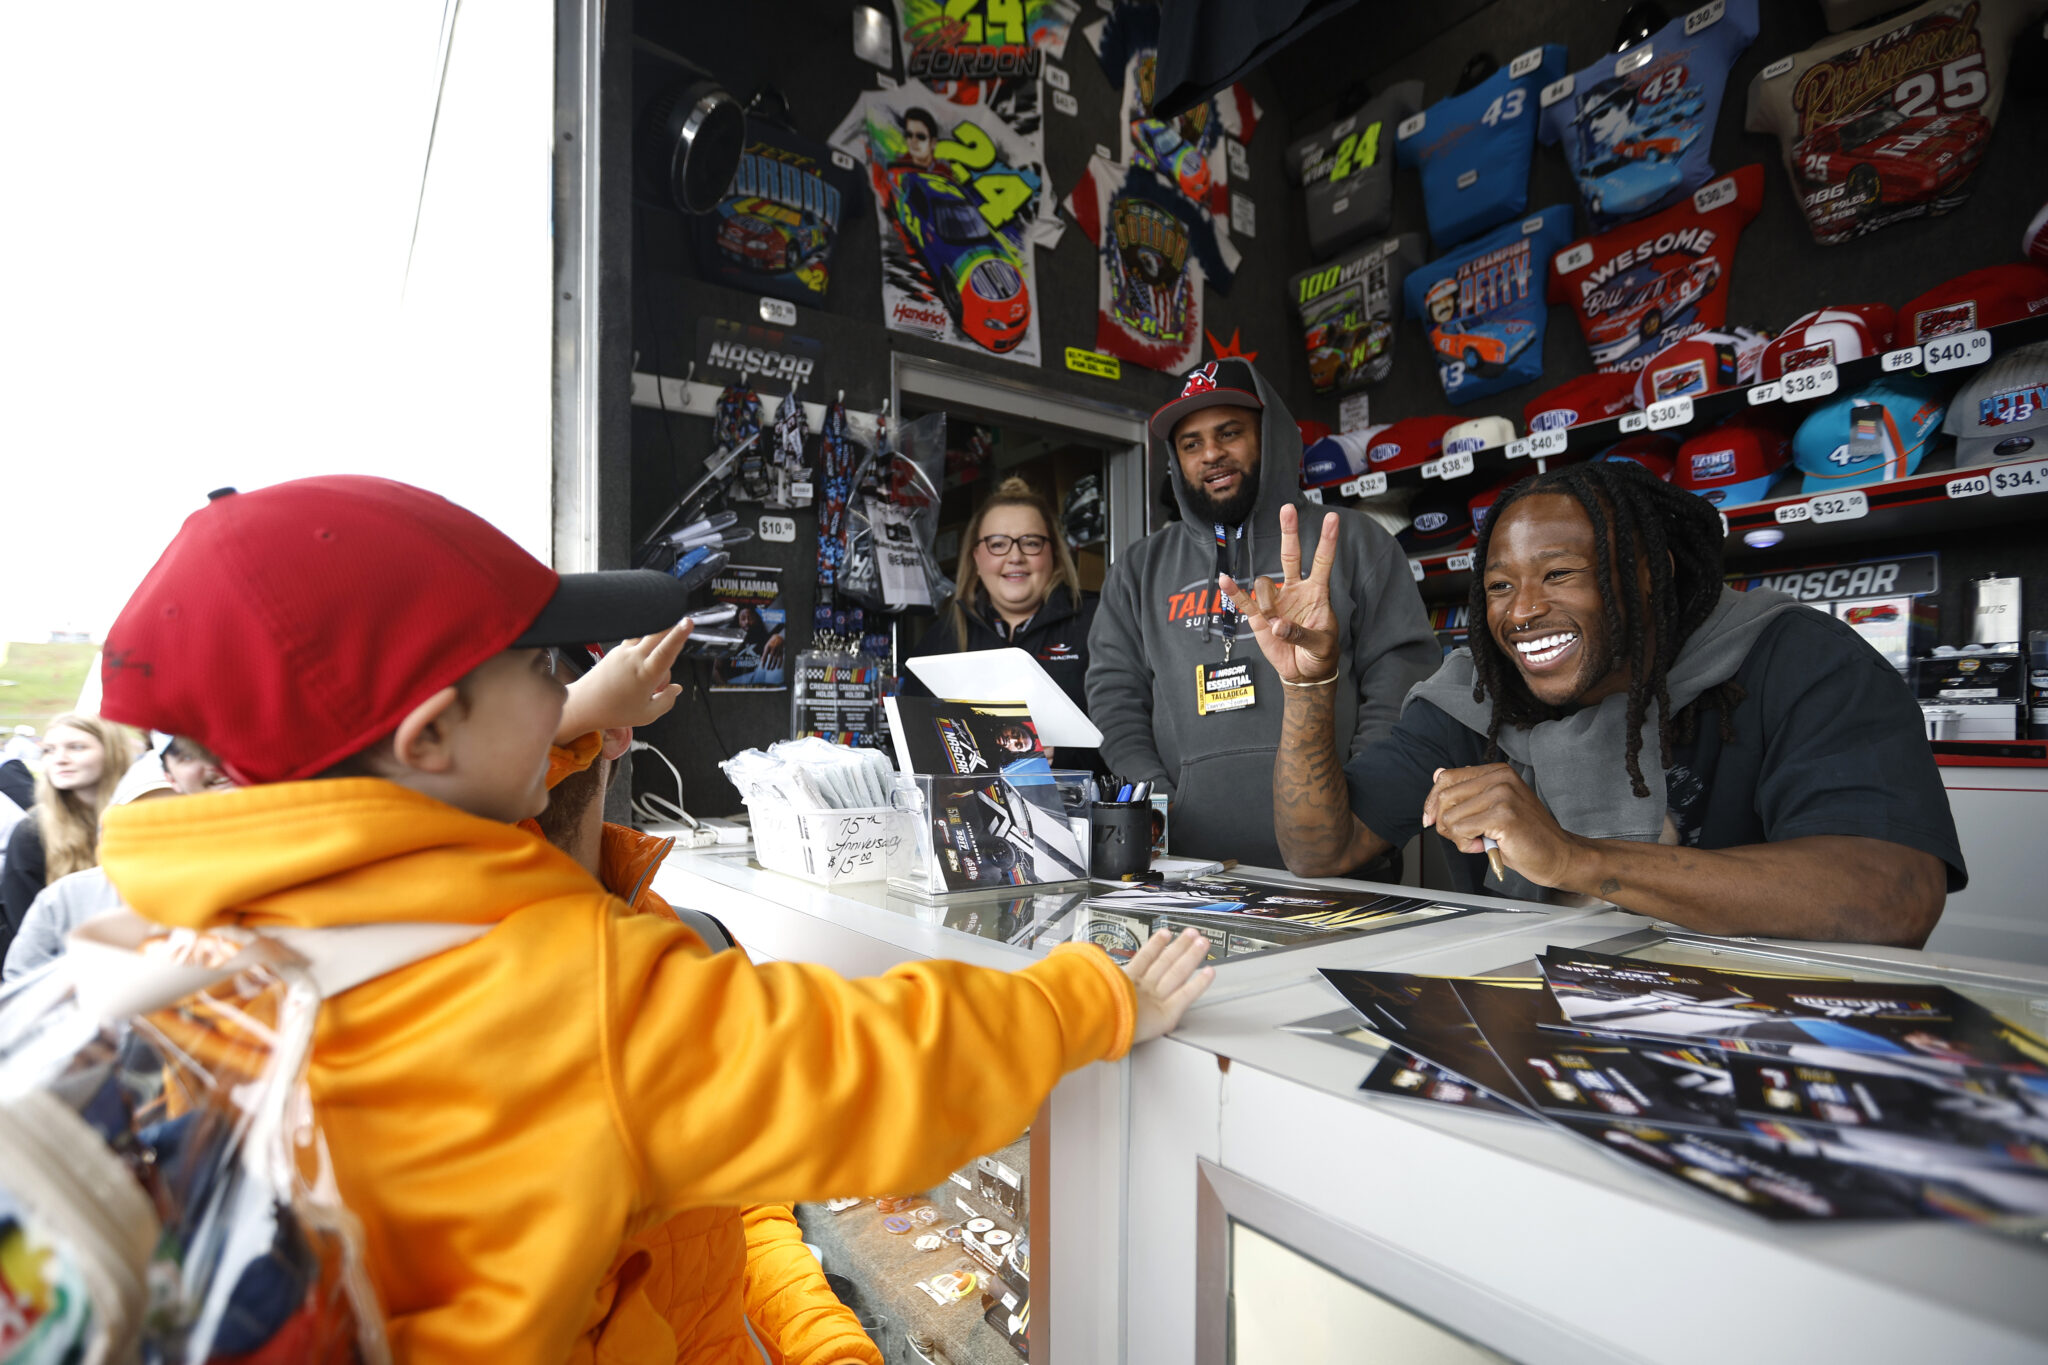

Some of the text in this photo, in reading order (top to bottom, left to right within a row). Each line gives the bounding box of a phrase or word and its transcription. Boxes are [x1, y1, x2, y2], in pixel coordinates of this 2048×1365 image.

[944, 0, 1028, 44] 24
[1853, 24, 1912, 57] TIM
[908, 48, 1042, 80] GORDON
[1795, 1, 1980, 138] Richmond
[1641, 66, 1684, 102] 43
[1894, 53, 1989, 118] 25
[1481, 87, 1527, 127] 43
[1329, 121, 1382, 182] 24
[933, 120, 1034, 232] 24
[1805, 154, 1831, 182] 25
[727, 153, 841, 234] ORDON
[1114, 209, 1189, 271] GORDON
[1580, 227, 1717, 298] AWESOME
[1299, 265, 1342, 304] 100
[1459, 251, 1531, 318] PETTY
[893, 303, 947, 326] Hendrick
[1582, 288, 1626, 318] Bill
[1659, 321, 1705, 348] From
[707, 341, 815, 384] NASCAR
[1891, 337, 1987, 367] #8 $40.00
[1756, 370, 1833, 400] #7 $38.00
[1626, 416, 1642, 428] #6
[1650, 402, 1691, 423] $30.00
[1978, 385, 2048, 423] PETTY
[2000, 403, 2034, 424] 43
[1531, 432, 1565, 451] $40.00
[1951, 479, 1985, 496] #40
[1779, 495, 1863, 521] #39 $32.00
[761, 520, 793, 535] $10.00
[1450, 558, 1468, 568] #36
[711, 578, 739, 590] ALVIN
[740, 580, 779, 593] KAMARA
[1206, 675, 1251, 691] ESSENTIAL
[1218, 664, 1246, 678] NASCAR
[1211, 688, 1248, 701] TALLADEGA
[943, 730, 971, 775] NASCAR
[840, 815, 882, 836] 75th
[965, 821, 974, 839] ALVIN
[827, 834, 901, 856] Anniversary
